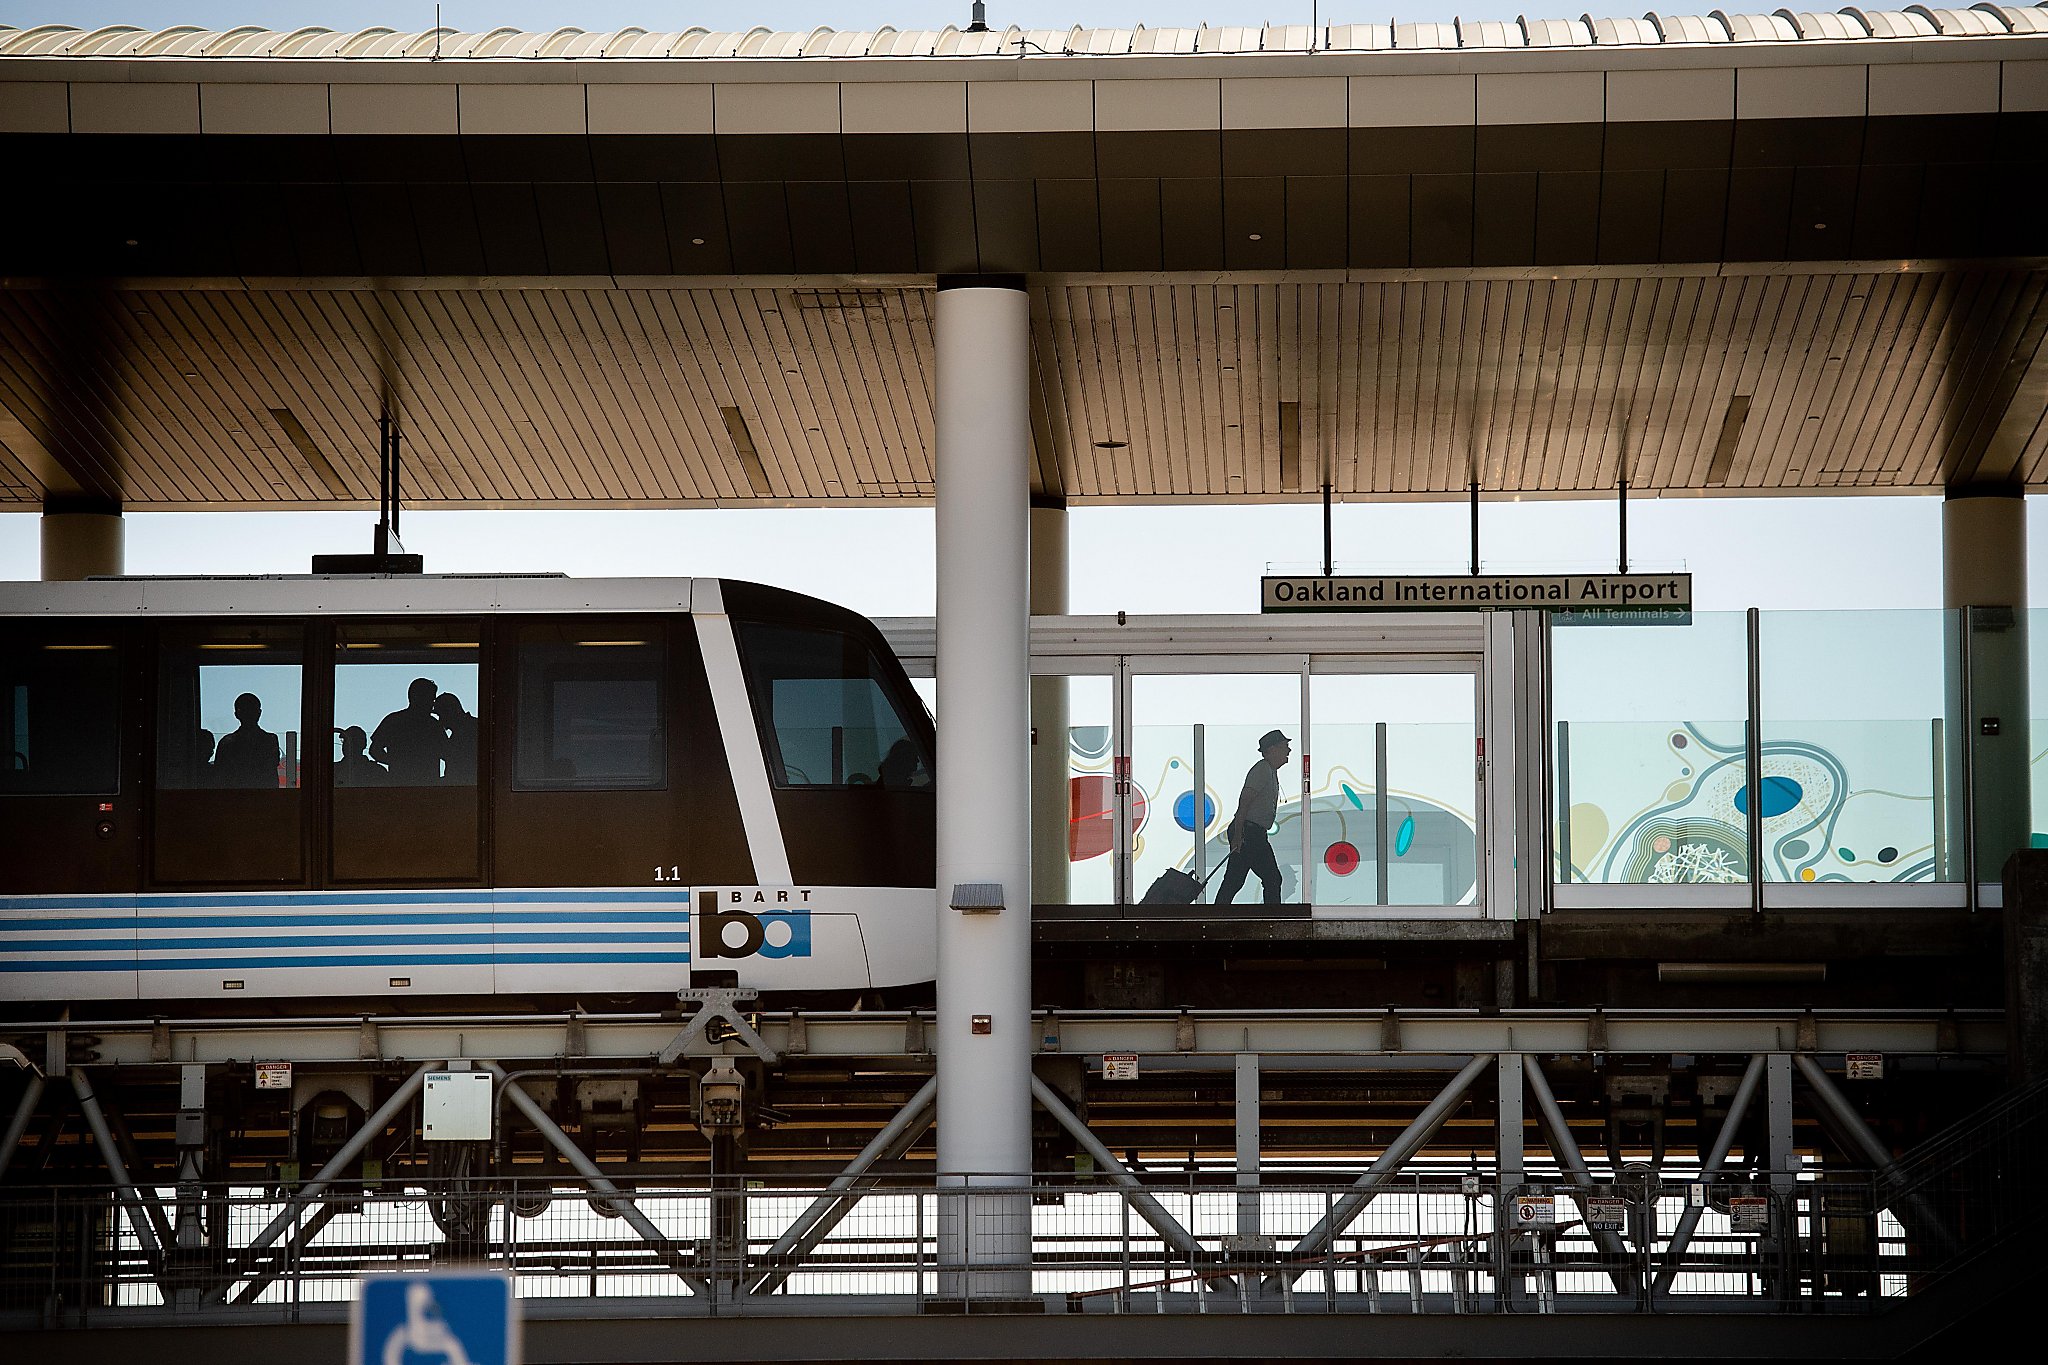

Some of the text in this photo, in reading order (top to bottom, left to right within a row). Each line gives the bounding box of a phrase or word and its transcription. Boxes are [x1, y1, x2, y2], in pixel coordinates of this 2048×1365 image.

[1274, 578, 1679, 605] Oakland International Airport
[1582, 608, 1600, 620] All
[1605, 607, 1670, 620] Terminals
[654, 865, 681, 882] 1.1
[731, 890, 811, 903] BART
[1593, 1222, 1618, 1230] NO EXIT
